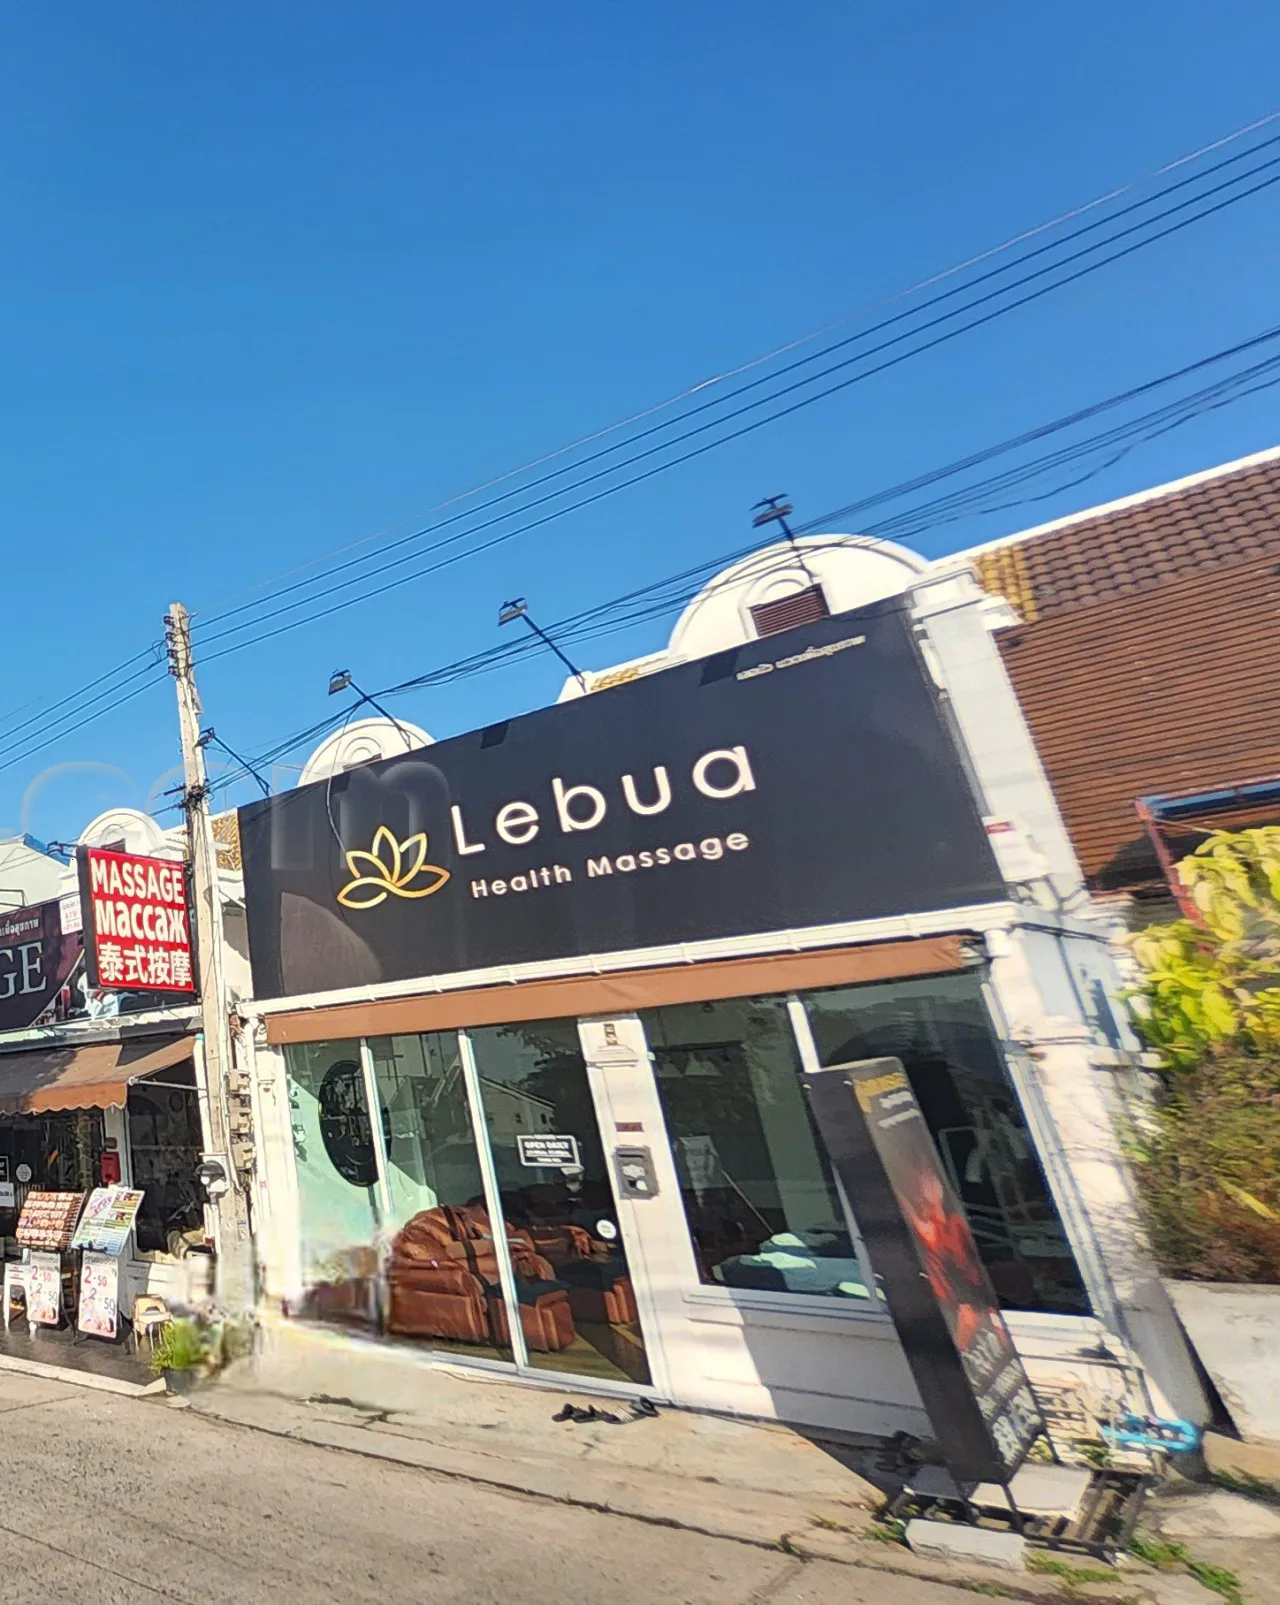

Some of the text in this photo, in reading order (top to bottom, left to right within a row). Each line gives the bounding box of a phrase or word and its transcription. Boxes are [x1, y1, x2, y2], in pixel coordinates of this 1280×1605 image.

[451, 746, 757, 856] Lebua
[90, 856, 185, 905] MASSAGE
[471, 833, 750, 899] Health Massage
[94, 898, 188, 944] Массаж
[98, 942, 193, 987] 泰式按摩
